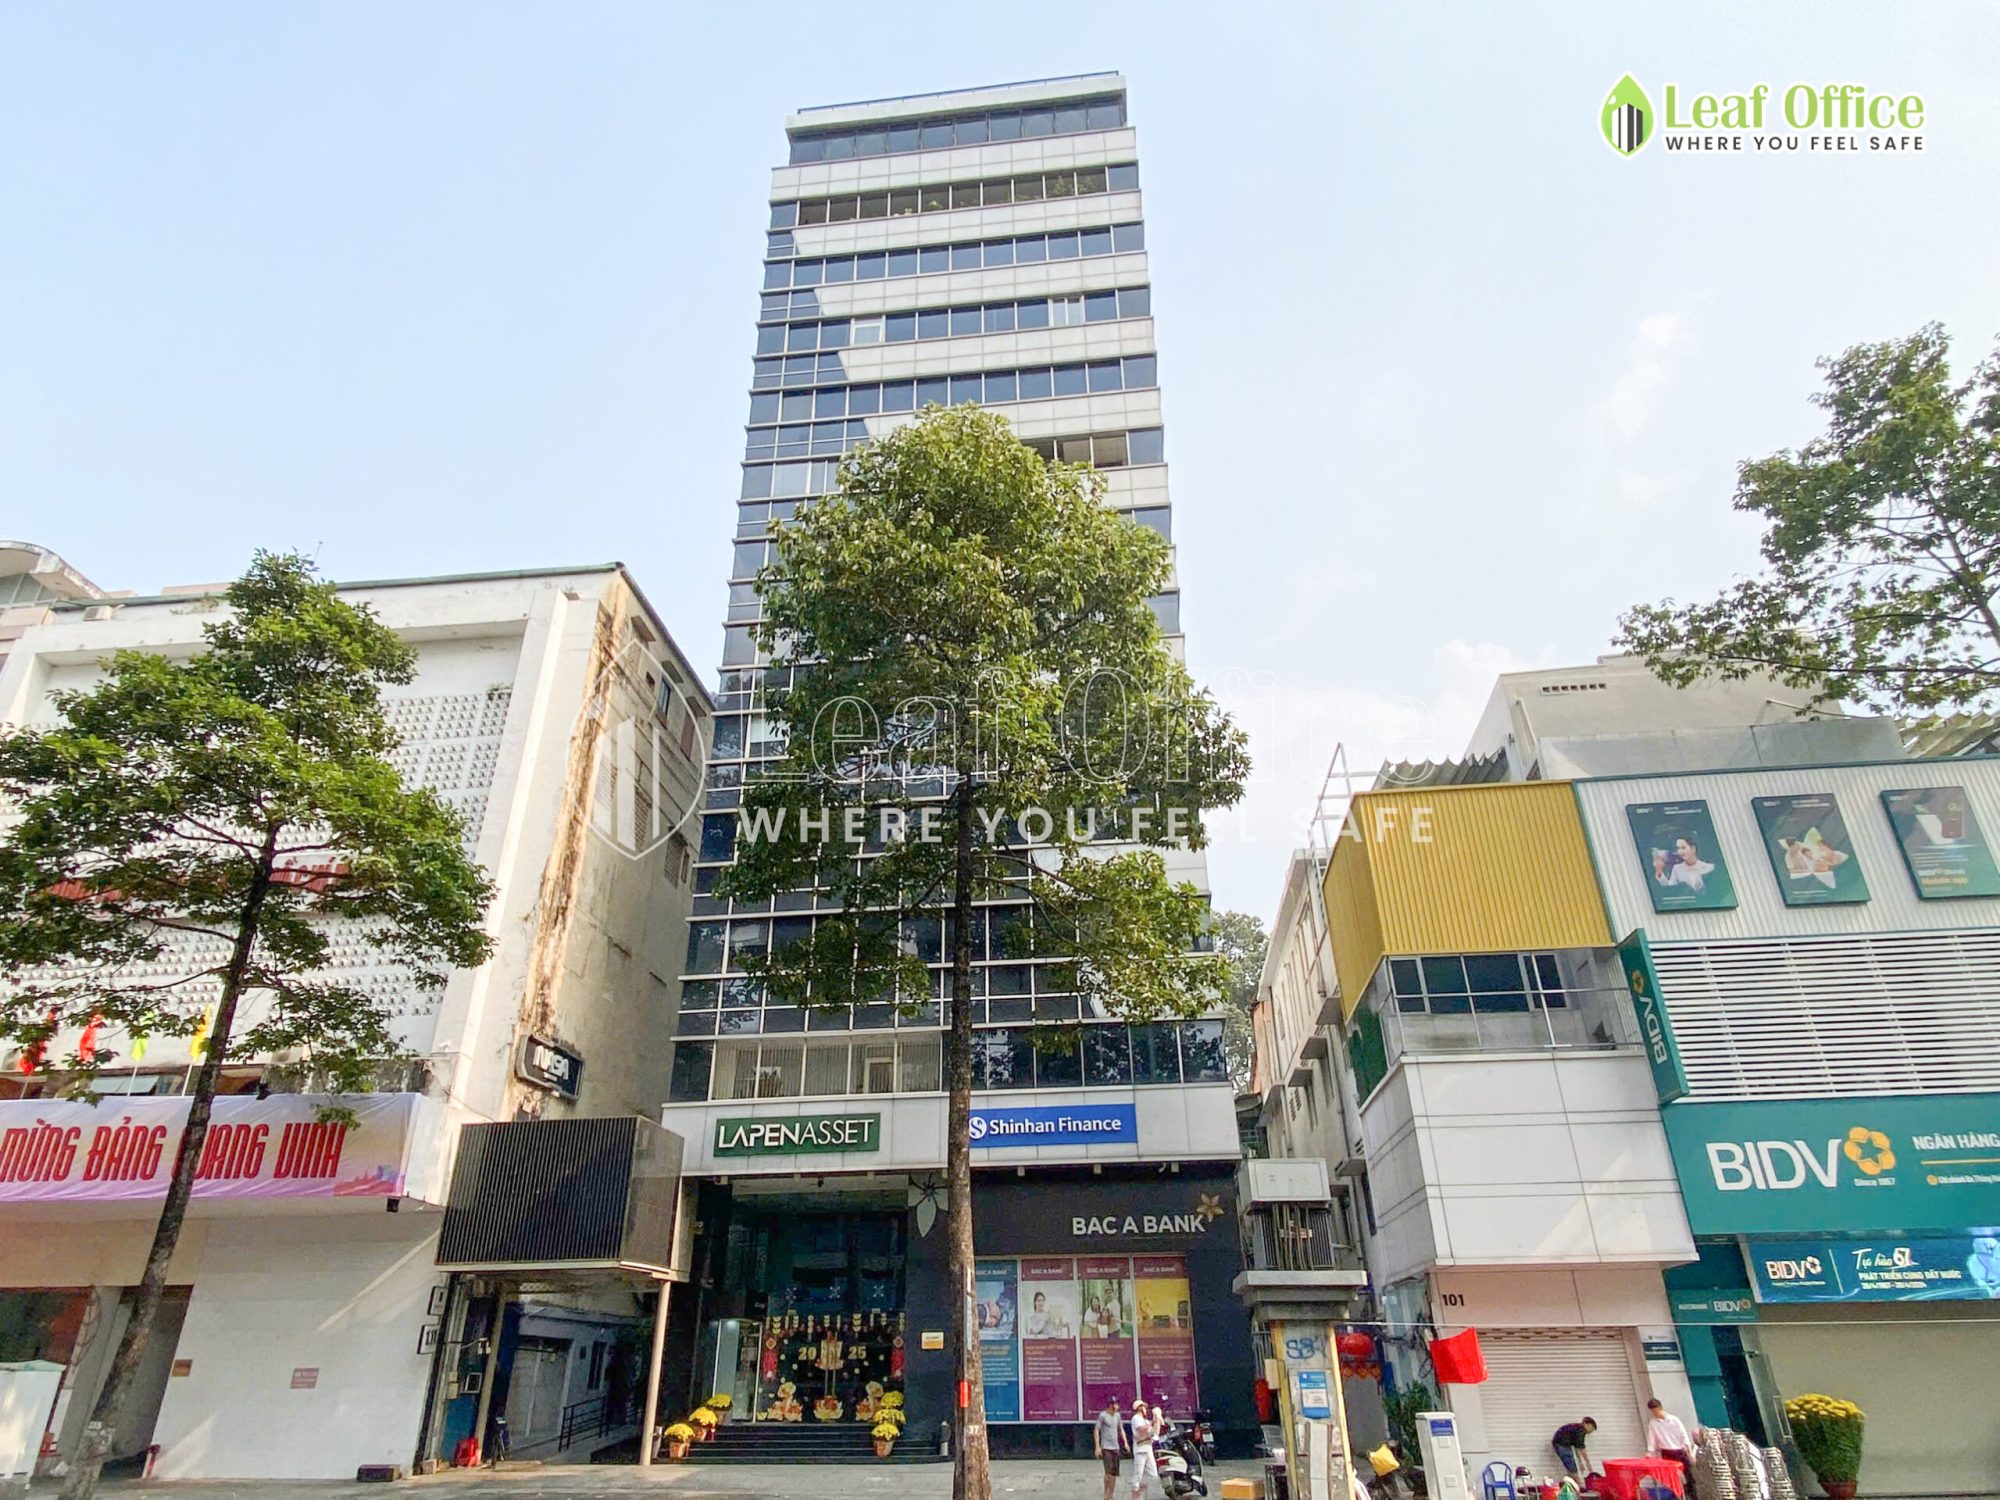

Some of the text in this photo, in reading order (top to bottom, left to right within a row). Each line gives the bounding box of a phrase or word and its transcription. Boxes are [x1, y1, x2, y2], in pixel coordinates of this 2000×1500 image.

[1638, 996, 1668, 1065] BIDV
[989, 1116, 1122, 1136] Shinhan Finance
[82, 1116, 168, 1181] ĐẢNG
[1912, 1133, 1956, 1151] NGÂN
[1706, 1139, 1842, 1191] BIDV
[1072, 1214, 1206, 1235] BAC A BANK
[1766, 1261, 1806, 1279] BIDV
[1442, 1293, 1465, 1307] 101
[1713, 1300, 1741, 1312] BIDV
[798, 1346, 867, 1361] 20 25
